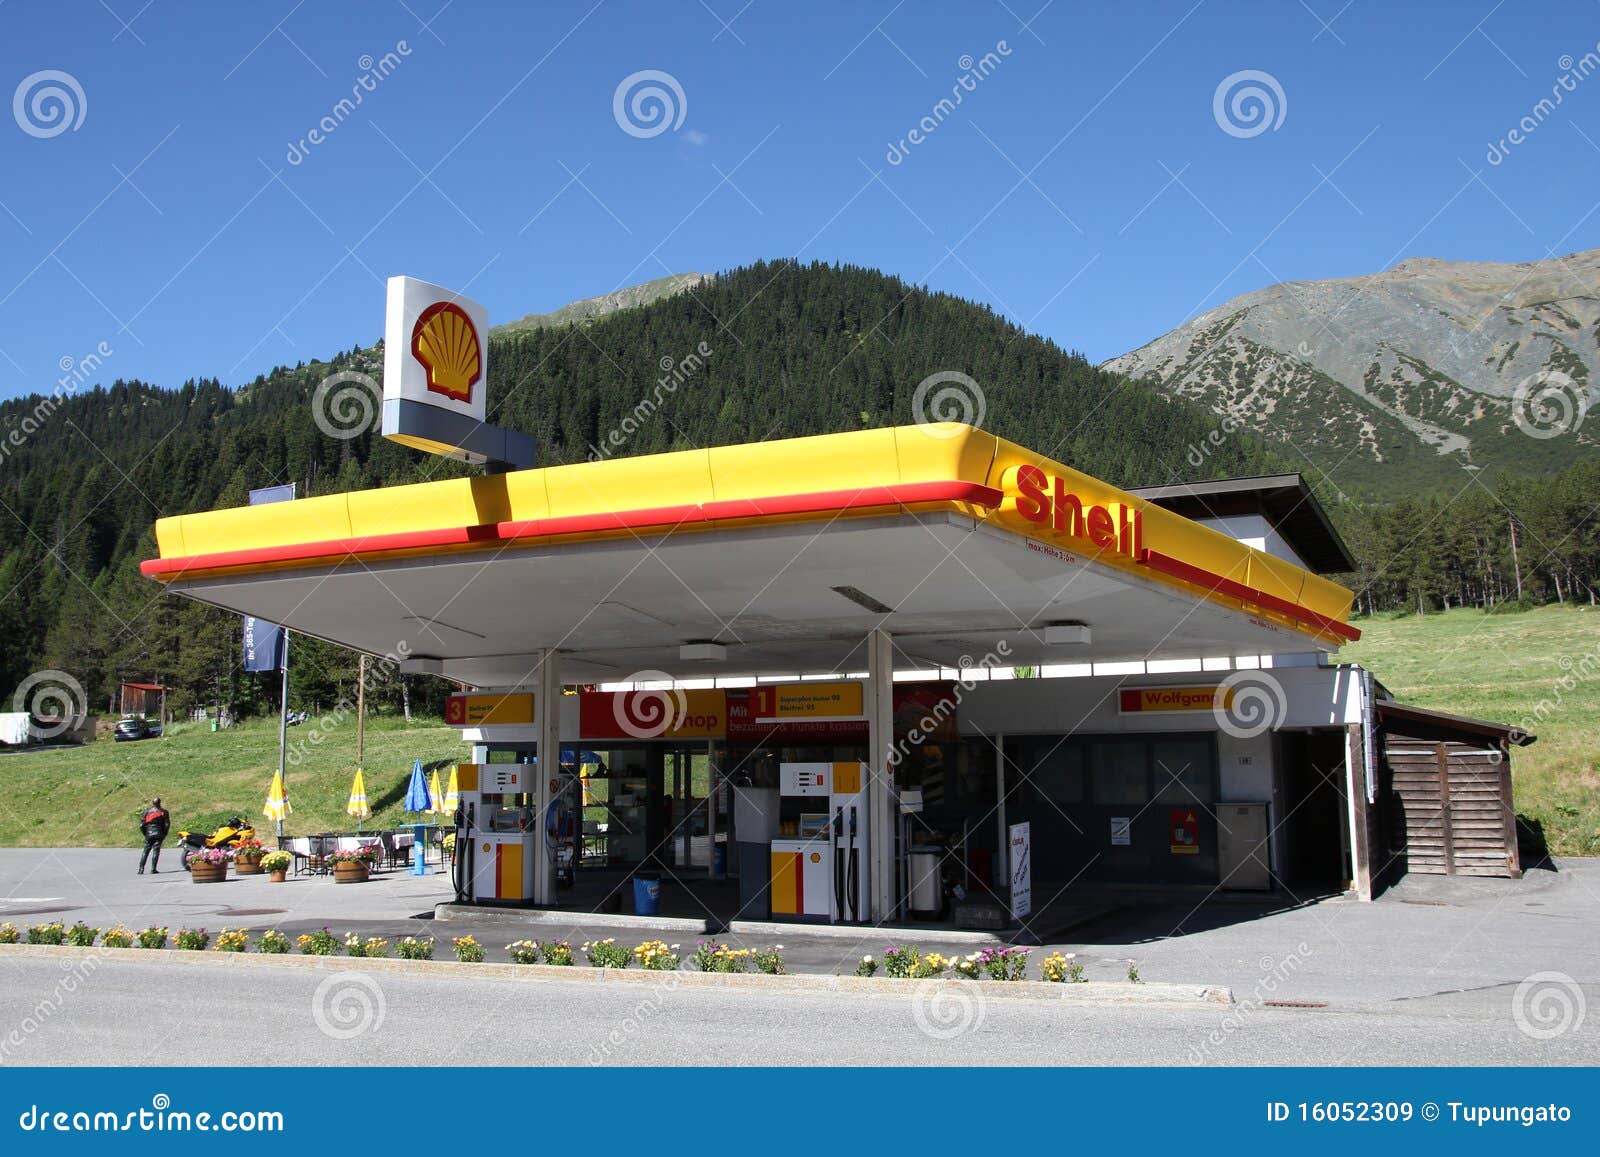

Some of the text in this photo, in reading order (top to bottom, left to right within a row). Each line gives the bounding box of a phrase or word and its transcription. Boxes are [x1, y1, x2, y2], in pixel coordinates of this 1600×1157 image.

[1014, 464, 1143, 561] Shell
[758, 691, 767, 713] 1
[1145, 691, 1220, 707] Wolfgang
[450, 702, 461, 720] 3
[730, 706, 748, 717] Mit
